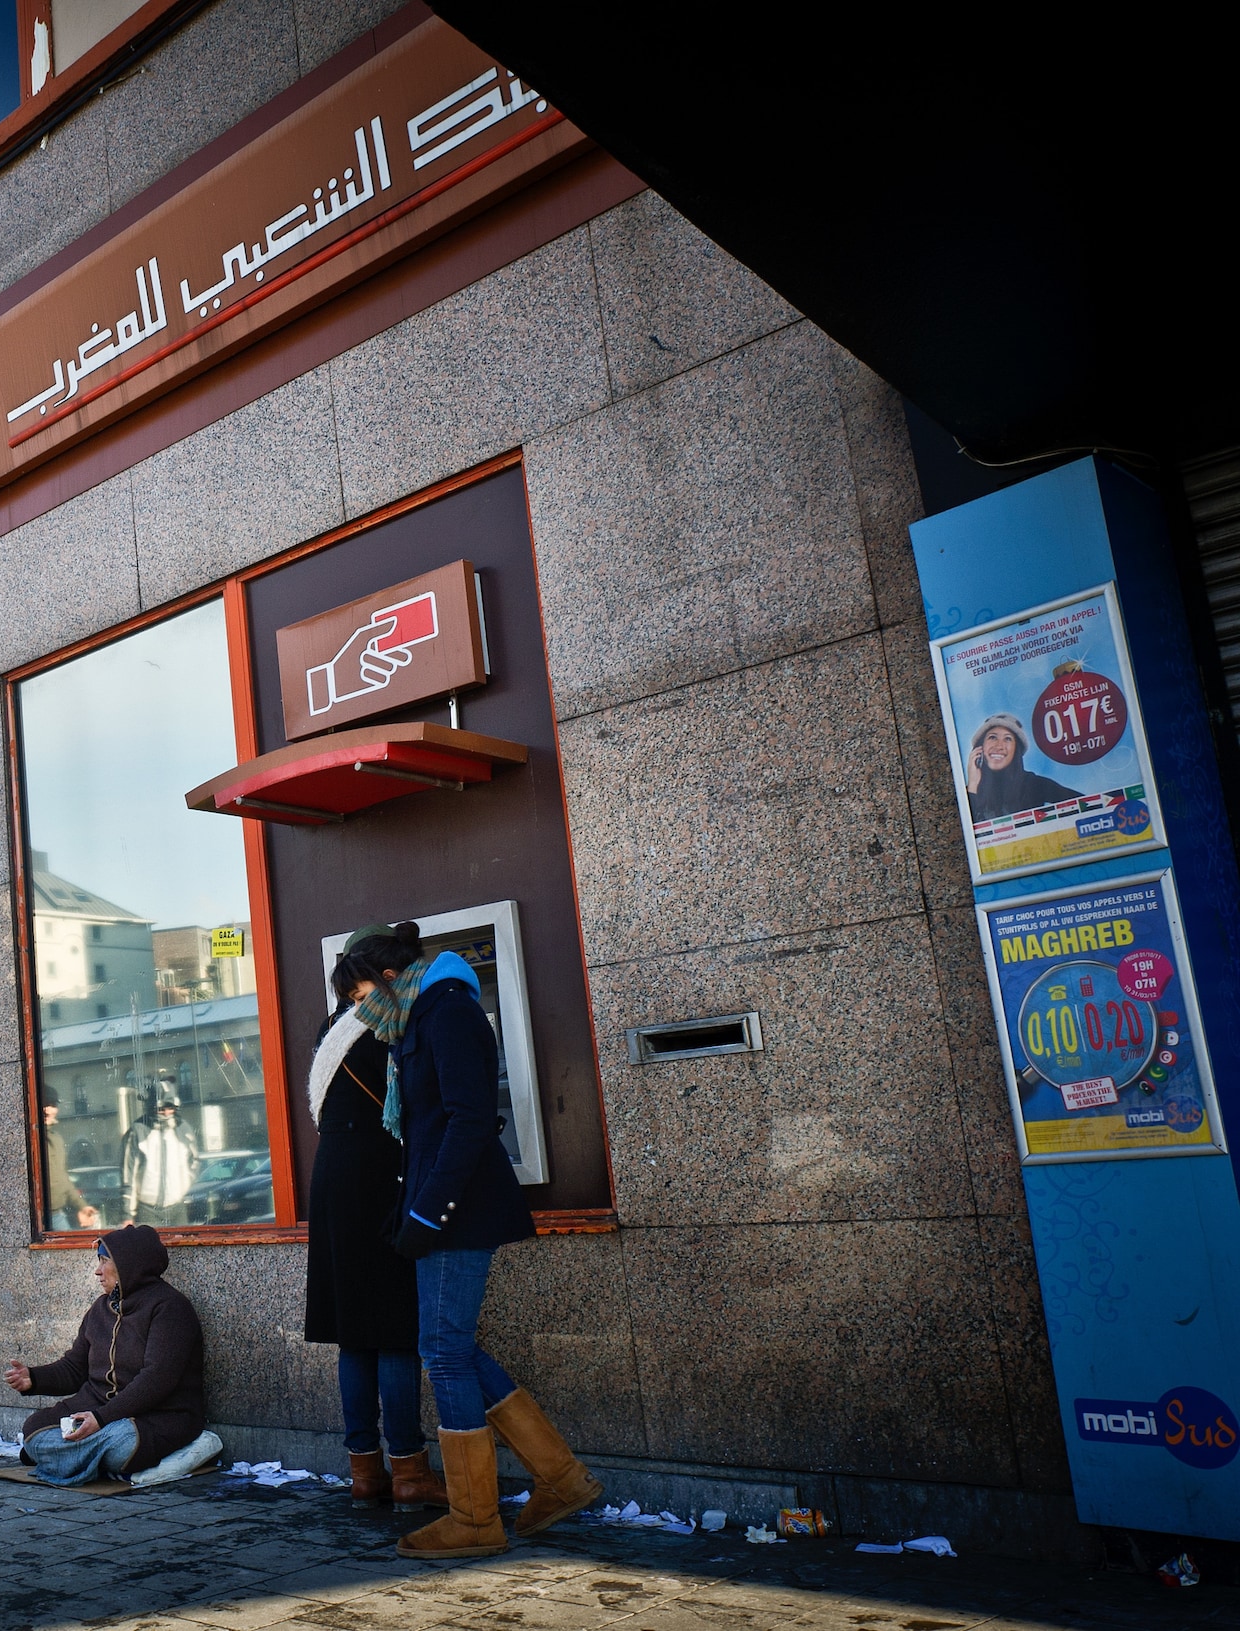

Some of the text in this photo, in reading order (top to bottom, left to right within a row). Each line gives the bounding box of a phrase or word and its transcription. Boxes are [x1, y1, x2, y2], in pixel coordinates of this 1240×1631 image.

[6, 257, 167, 423] للمغرب
[946, 655, 955, 665] LE
[957, 644, 988, 661] SOURIRE
[990, 635, 1014, 650] PASSE
[1015, 628, 1039, 641] AUSSI
[1040, 621, 1057, 633] PAR
[1058, 617, 1069, 627] UN
[1071, 608, 1097, 624] APPEL
[966, 624, 1084, 669] EEN GLIMLACH WORDT OOK VIA
[972, 636, 1079, 677] EEN OPROEP DOORGEGEVEN!
[1044, 682, 1109, 708] FIXE/VASTE LIJN
[1063, 680, 1083, 692] GSM
[1079, 816, 1114, 834] mobi
[995, 890, 1156, 925] TARIF CHOC POUR TOUS VOS APPELS VERS LE
[997, 901, 1158, 936] STUNTPRIJS OP AL UW GESPREKKEN NAAR DE
[1000, 918, 1134, 964] MAGHREB
[1132, 960, 1154, 972] 19H
[1135, 977, 1157, 990] 07H
[1027, 1000, 1144, 1058] 0,10 0,20
[1066, 1092, 1086, 1101] PRICE
[1097, 1087, 1112, 1095] THE
[1071, 1081, 1103, 1092] THE BEST
[1075, 1096, 1107, 1106] MARKET!
[1128, 1105, 1165, 1124] mobi
[1083, 1410, 1158, 1436] mobi
